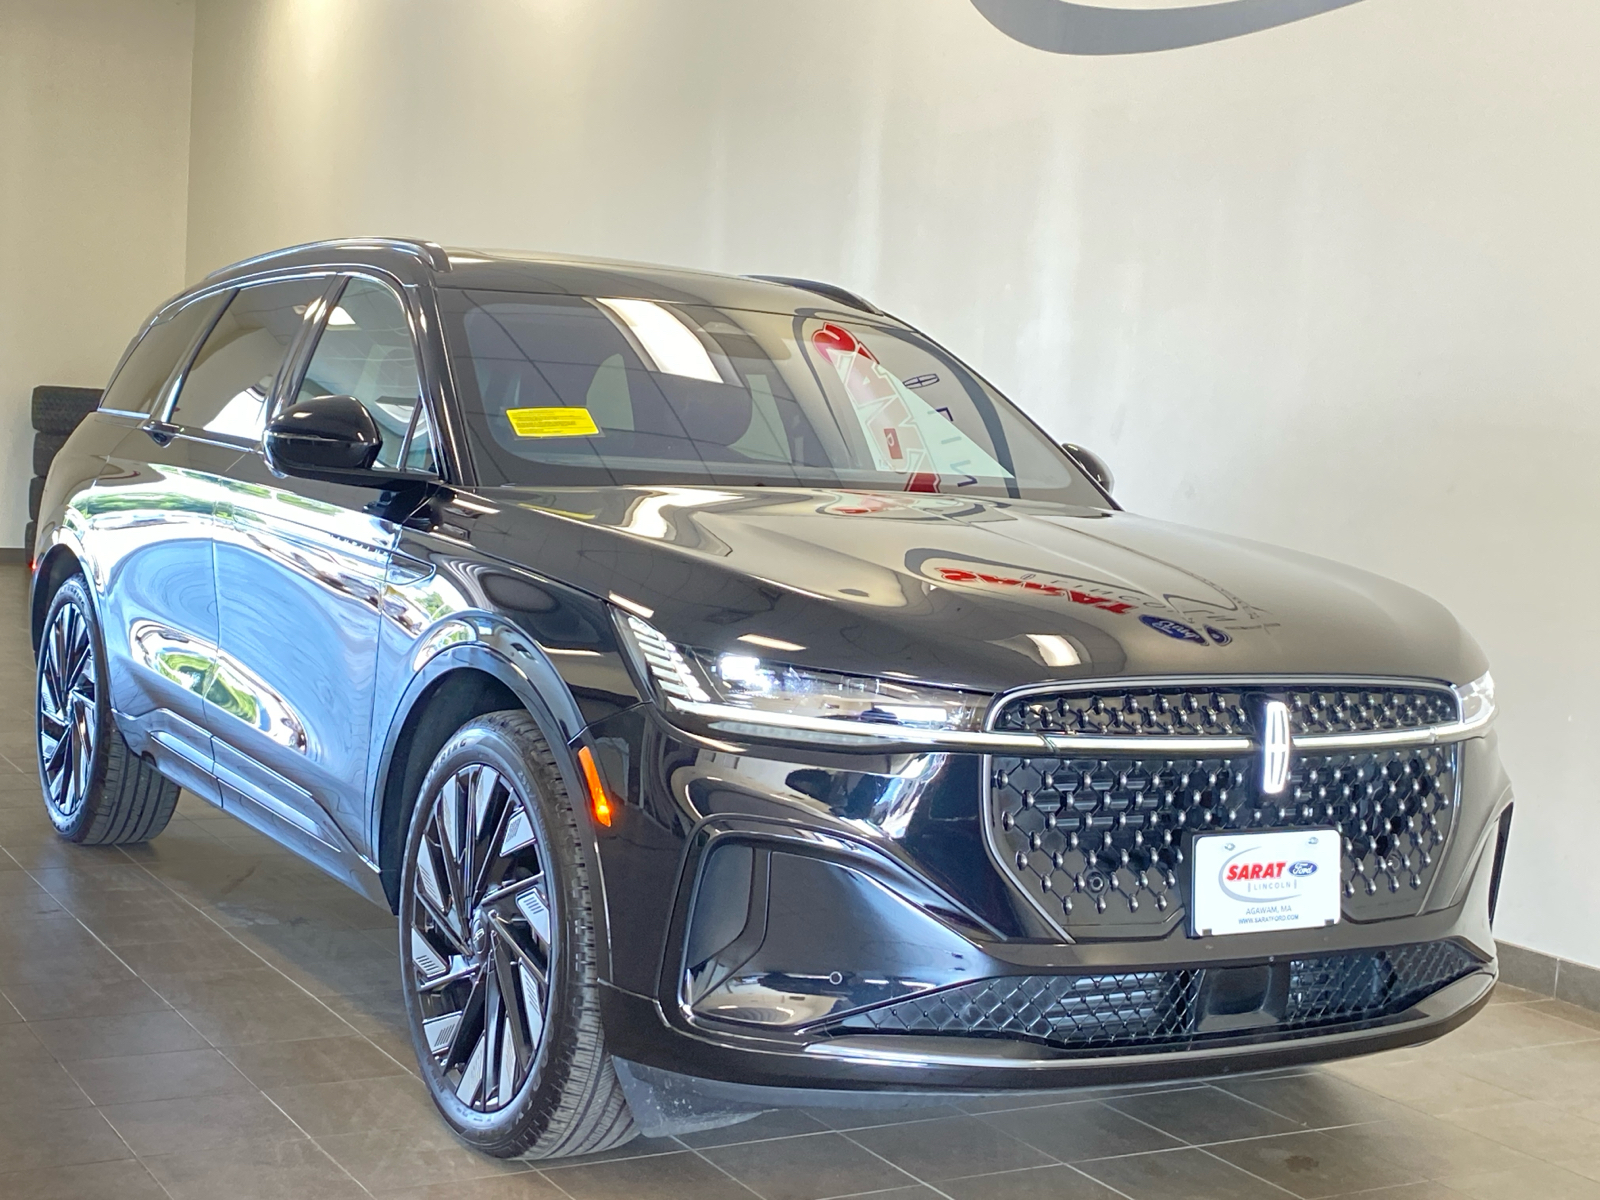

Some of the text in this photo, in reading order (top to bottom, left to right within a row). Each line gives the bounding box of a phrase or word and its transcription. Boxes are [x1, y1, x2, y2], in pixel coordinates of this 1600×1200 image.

[1226, 860, 1315, 881] SARAT Ford
[1253, 881, 1291, 890] LINCOLN
[1246, 906, 1279, 915] AGAWAM,
[1238, 914, 1299, 924] WWW.SARATFORD.COM
